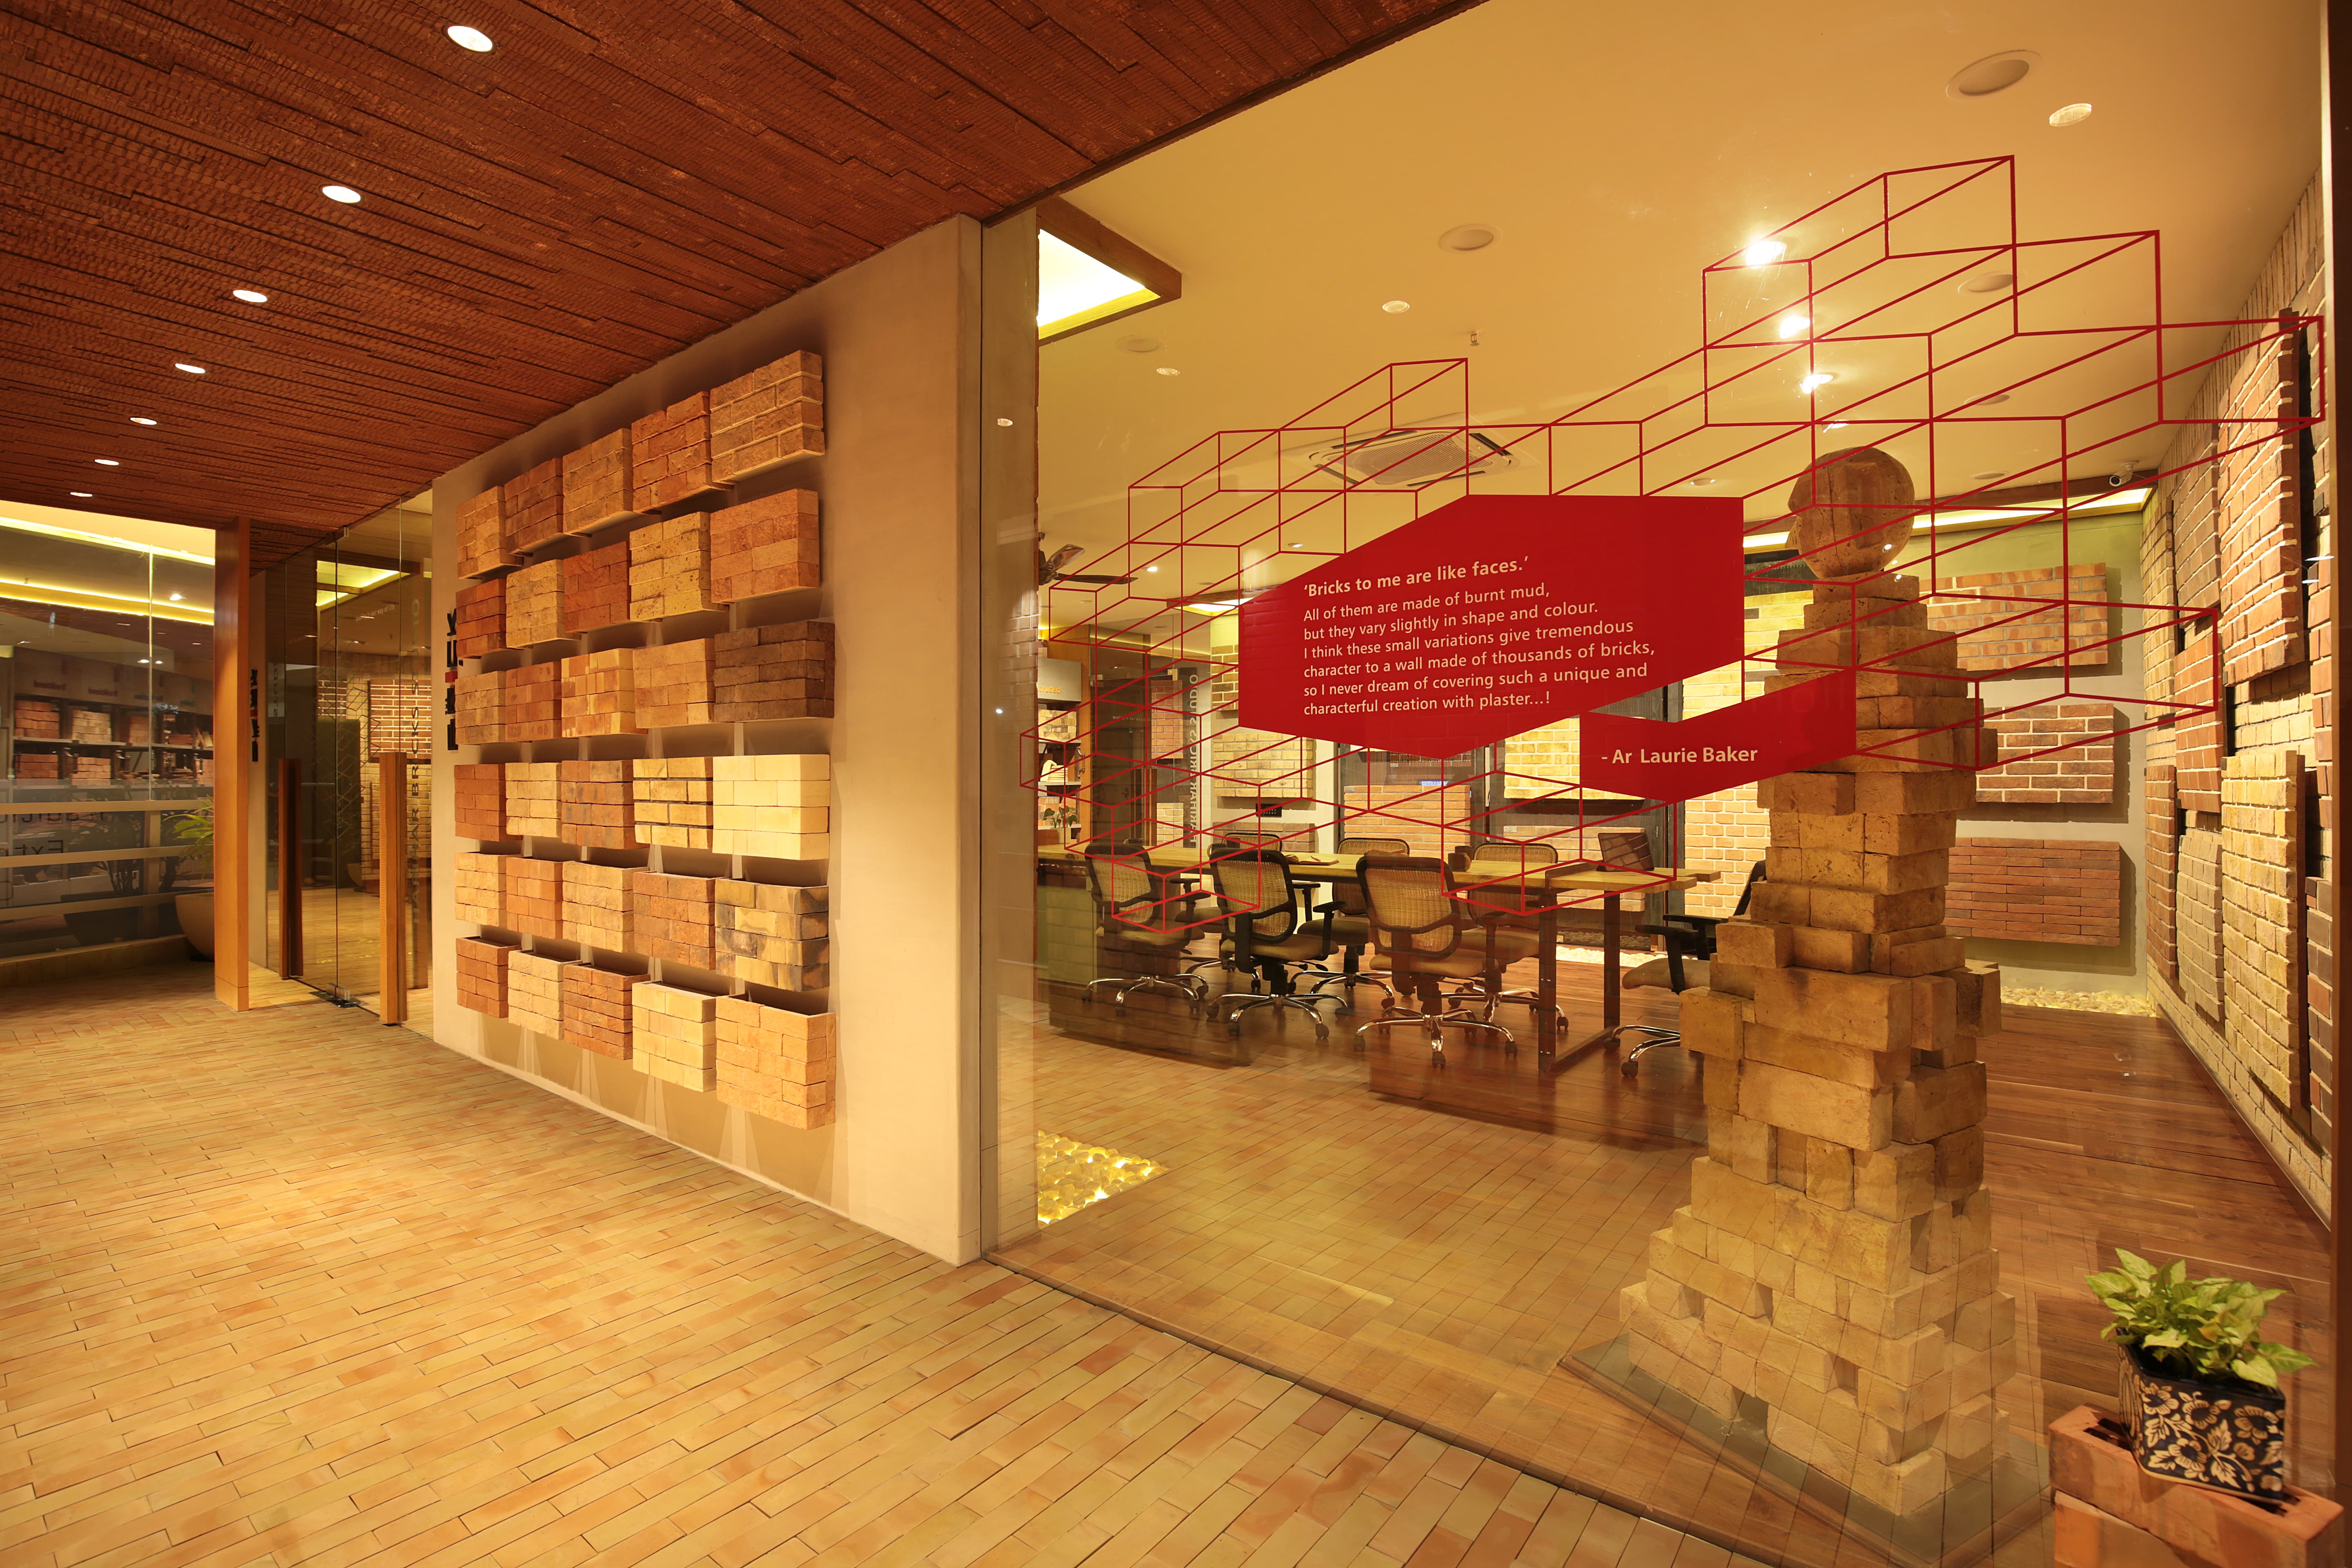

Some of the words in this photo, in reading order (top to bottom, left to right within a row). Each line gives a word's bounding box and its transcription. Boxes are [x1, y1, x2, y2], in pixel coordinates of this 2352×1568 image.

[1355, 578, 1372, 591] to
[1377, 575, 1401, 588] me
[1406, 571, 1432, 585] are
[1437, 564, 1467, 581] like
[1303, 608, 1319, 622] All
[1323, 606, 1337, 619] of
[1340, 604, 1373, 618] them
[1377, 602, 1398, 614] are
[1403, 595, 1441, 611] made
[1445, 591, 1460, 606] of
[1465, 588, 1506, 604] burnt
[1511, 582, 1550, 599] mud,
[1304, 628, 1325, 640] but
[1328, 625, 1356, 639] they
[1359, 623, 1386, 637] vary
[1390, 615, 1439, 634] slightly
[1444, 613, 1457, 627] in
[1461, 610, 1505, 626] shape
[1510, 604, 1538, 621] and
[1544, 601, 1599, 617] colour.
[1304, 647, 1307, 659] I
[1311, 644, 1343, 659] think
[1346, 642, 1381, 655] these
[1385, 636, 1420, 652] small
[1424, 633, 1494, 646] variations
[1499, 630, 1530, 646] give
[1535, 620, 1634, 639] tremendous
[1303, 664, 1361, 678] character
[1365, 662, 1379, 673] to
[1383, 662, 1391, 672] a
[1395, 656, 1423, 671] wall
[1428, 653, 1467, 669] made
[1471, 651, 1487, 666] of
[1491, 645, 1572, 664] thousands
[1577, 643, 1595, 658] of
[1601, 640, 1655, 657] bricks,
[1303, 687, 1317, 697] so
[1321, 684, 1325, 695] I
[1329, 684, 1364, 695] never
[1367, 679, 1409, 693] dream
[1414, 676, 1429, 690] of
[1432, 676, 1493, 689] covering
[1499, 669, 1533, 685] such
[1539, 672, 1548, 683] a
[1554, 668, 1610, 684] unique
[1615, 662, 1647, 678] and
[1303, 699, 1379, 715] characterful
[1382, 698, 1437, 713] creation
[1442, 694, 1474, 709] with
[1612, 749, 1633, 764] Ar
[1640, 747, 1697, 764] Laurie
[1703, 746, 1758, 762] Baker
